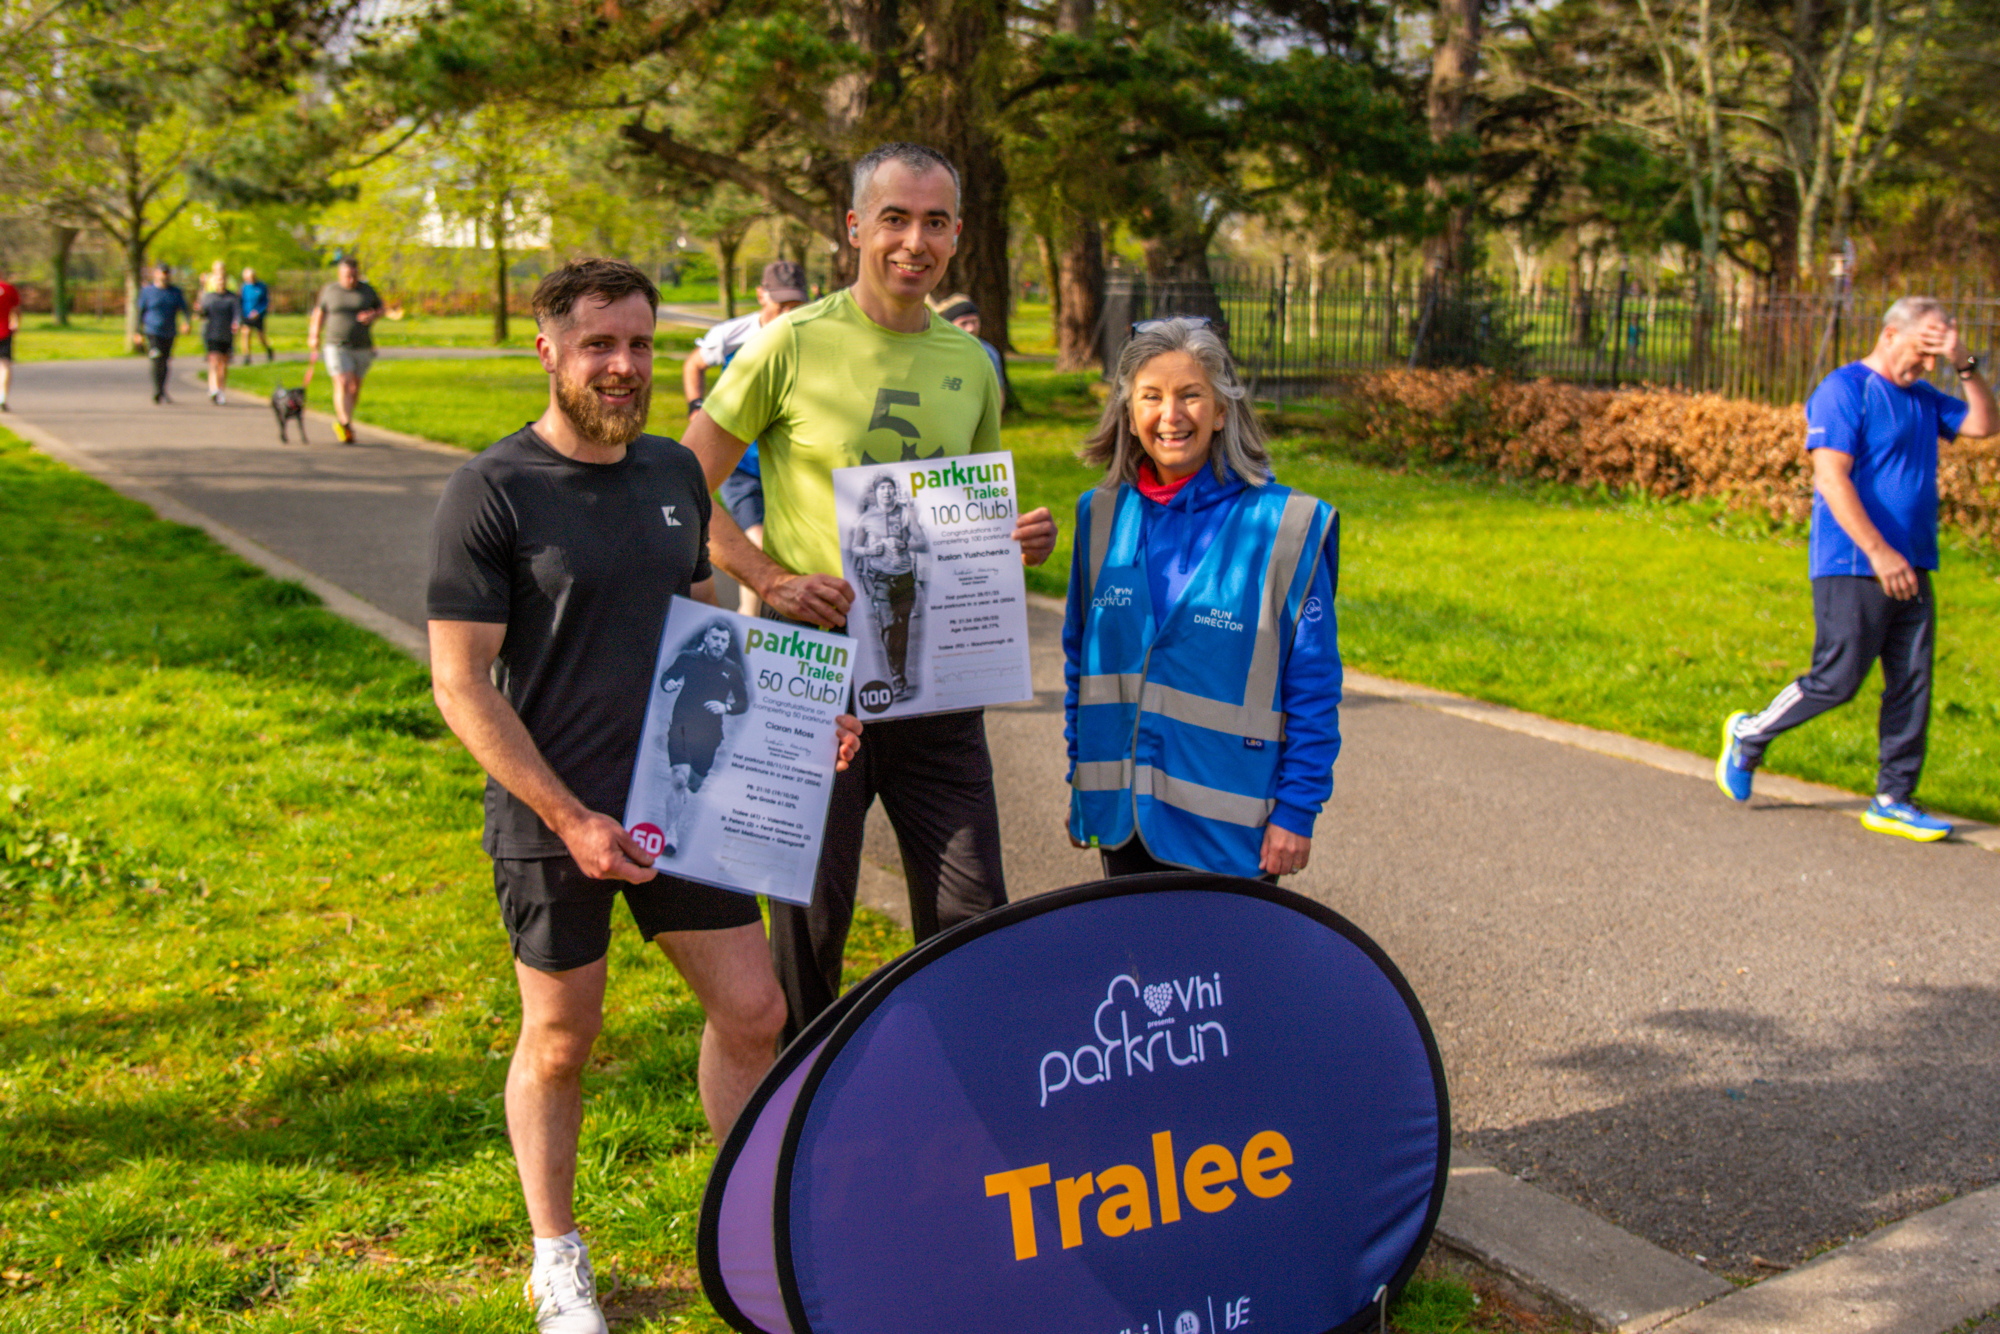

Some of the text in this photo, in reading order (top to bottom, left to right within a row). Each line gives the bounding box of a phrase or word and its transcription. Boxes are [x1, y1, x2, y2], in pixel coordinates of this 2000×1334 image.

[910, 461, 1007, 498] parkrun
[963, 484, 1009, 500] Tralee
[931, 499, 1013, 525] 100 Club!
[933, 537, 969, 546] completing
[971, 535, 982, 543] 100
[941, 526, 991, 538] Congratulations
[937, 549, 1010, 562] Ruslan Yushchenko
[1091, 590, 1131, 609] parkrun
[1194, 614, 1244, 632] DIRECTOR
[1210, 608, 1232, 620] RUN
[744, 628, 848, 668] parkrun
[798, 660, 844, 683] Tralee
[758, 669, 844, 706] 50 Club!
[763, 696, 815, 714] Congratulations
[860, 688, 891, 707] 100
[753, 703, 791, 718] completing
[793, 710, 801, 718] 50
[765, 721, 815, 739] Ciaran Moss
[744, 755, 766, 765] parkrun
[745, 766, 769, 775] parkruns
[732, 808, 748, 817] Tralee
[767, 817, 795, 828] Valentines
[741, 829, 770, 841] Melbourne
[775, 827, 802, 838] Greenway
[1173, 972, 1222, 1012] Vhi
[1147, 1017, 1175, 1029] presents
[1039, 1005, 1229, 1108] parkrun
[984, 1130, 1294, 1261] Tralee
